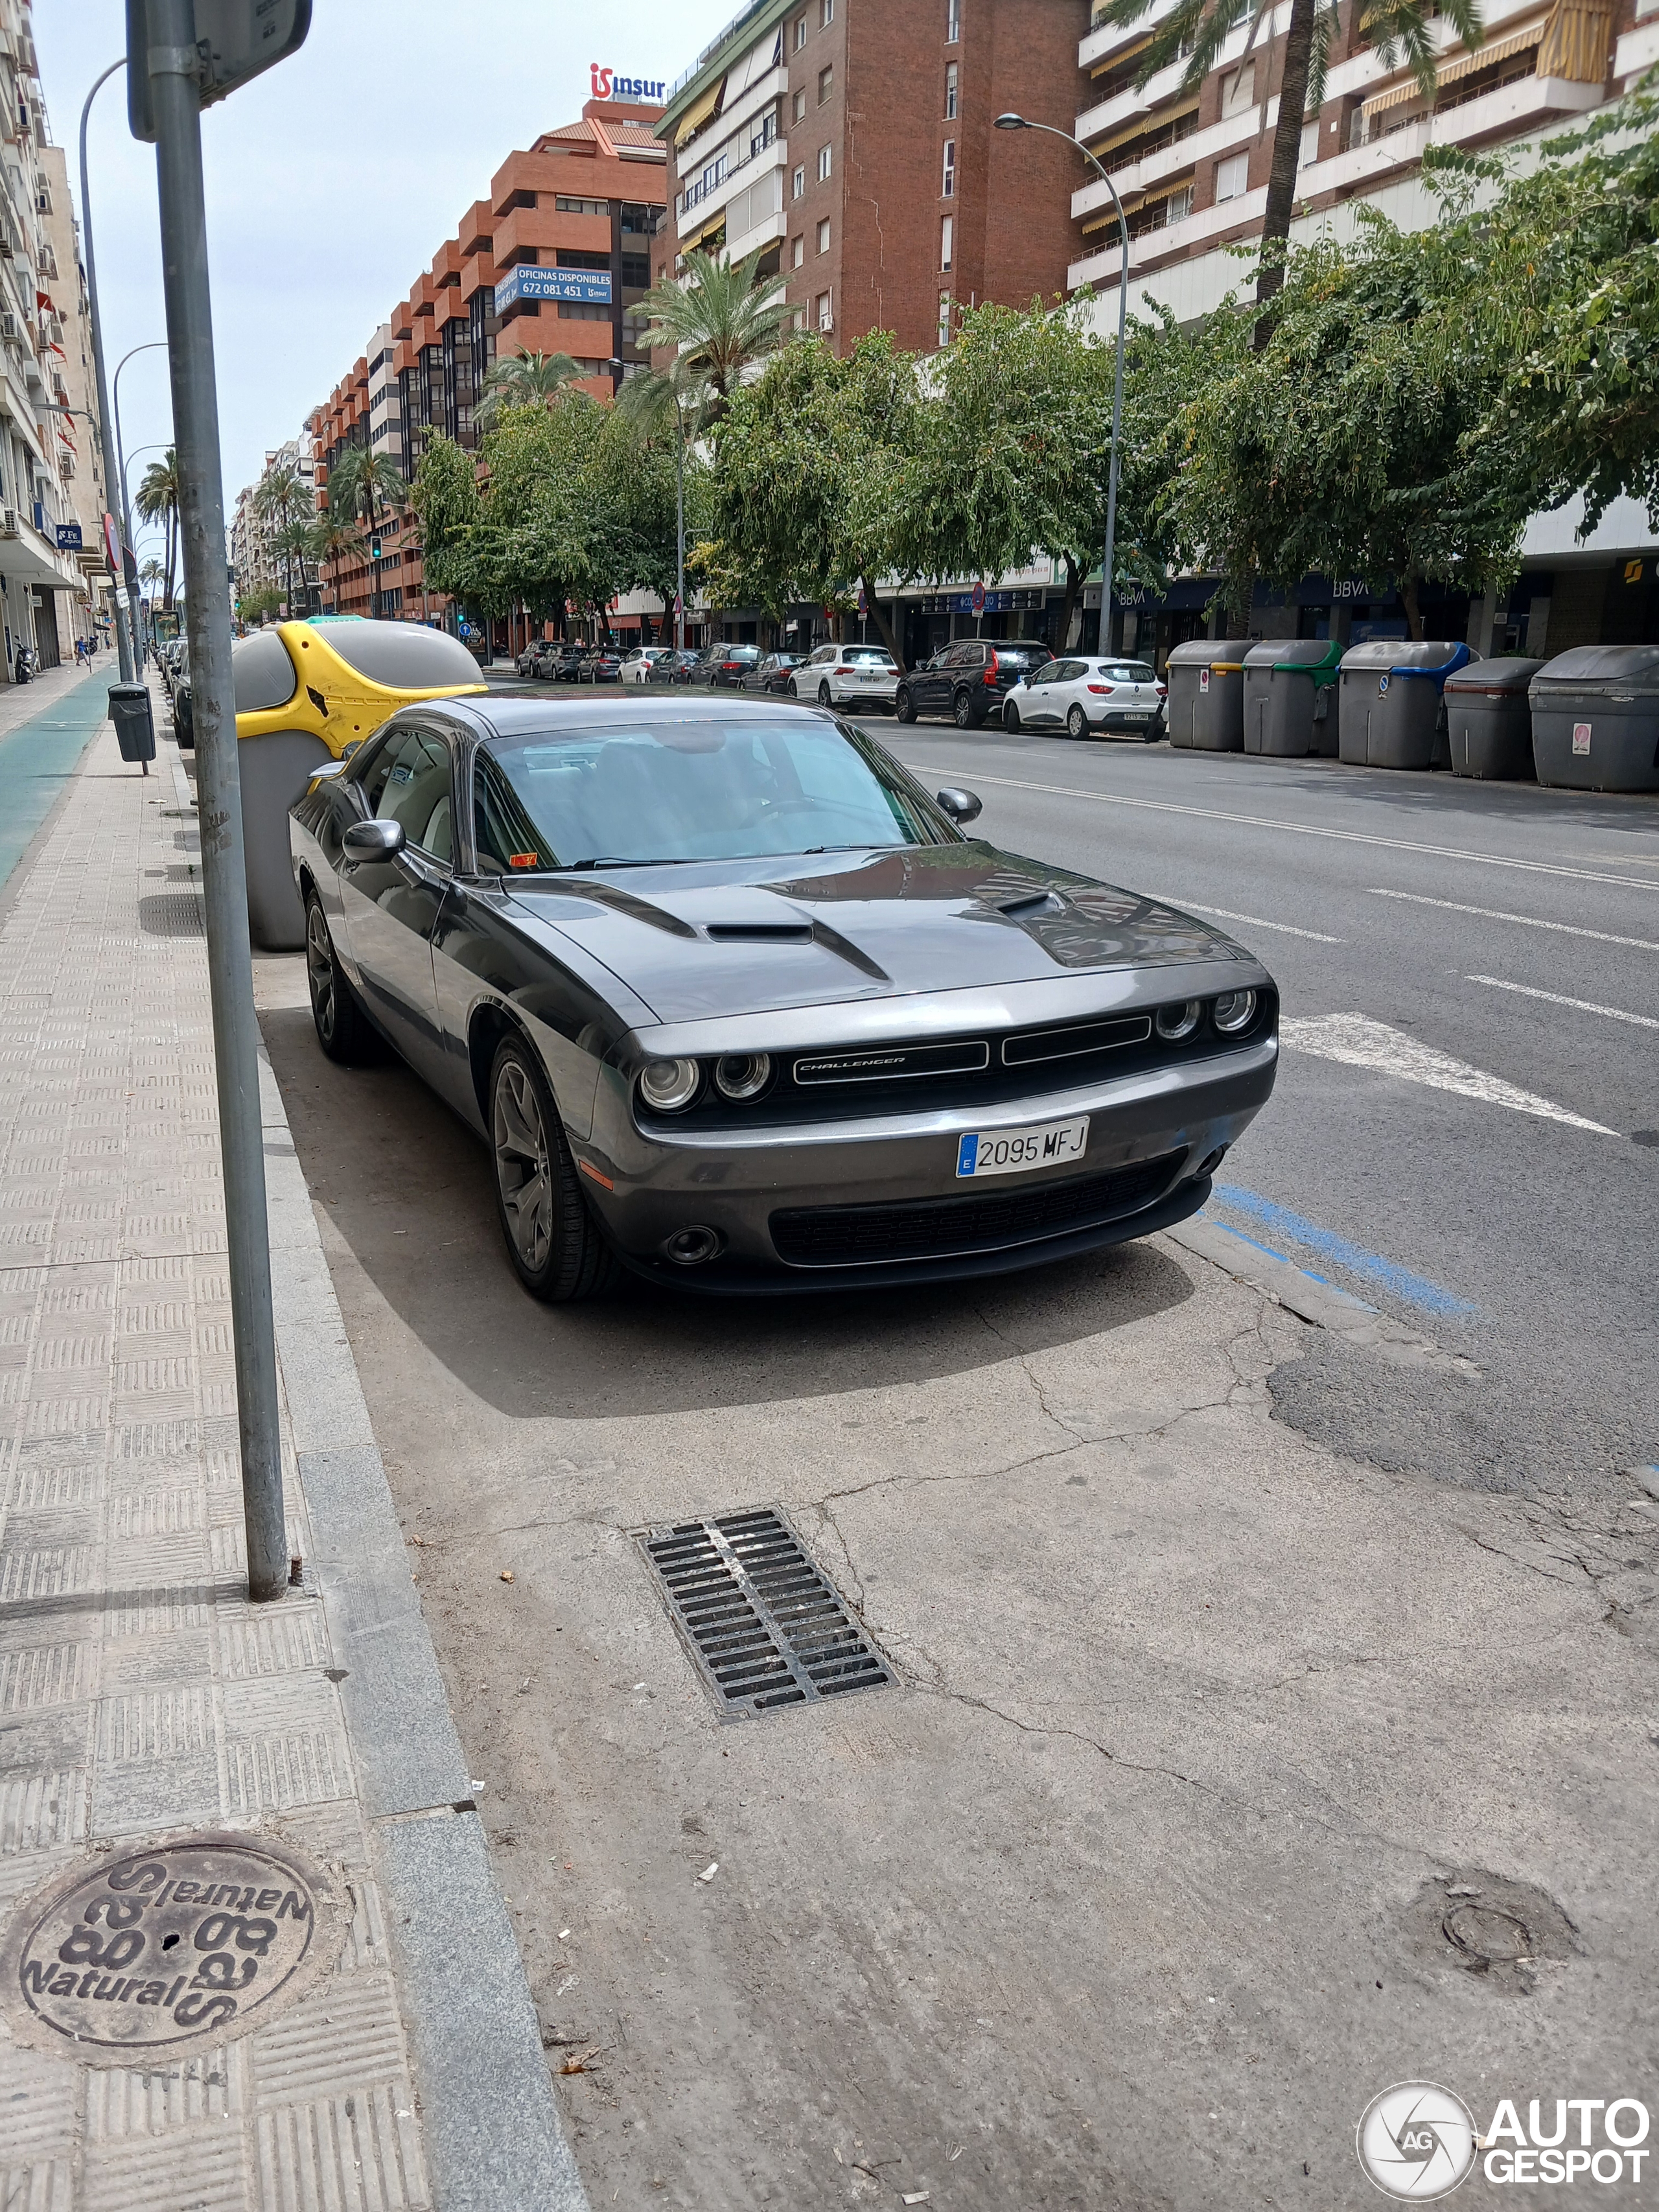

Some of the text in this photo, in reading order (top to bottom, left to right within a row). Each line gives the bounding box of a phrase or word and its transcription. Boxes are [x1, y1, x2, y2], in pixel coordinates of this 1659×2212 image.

[614, 76, 666, 98] insur
[519, 270, 610, 285] OFICINAS DISPONIBLES
[522, 283, 541, 294] 672
[543, 284, 562, 296] 081
[564, 286, 582, 297] 451
[1120, 589, 1145, 606] BBVA
[1333, 581, 1369, 598] BBVA
[800, 1057, 906, 1071] CHALLENGER
[963, 1126, 1085, 1169] E 2095 MFJ
[154, 1879, 310, 1920] Natural
[23, 1960, 187, 2007] Natural
